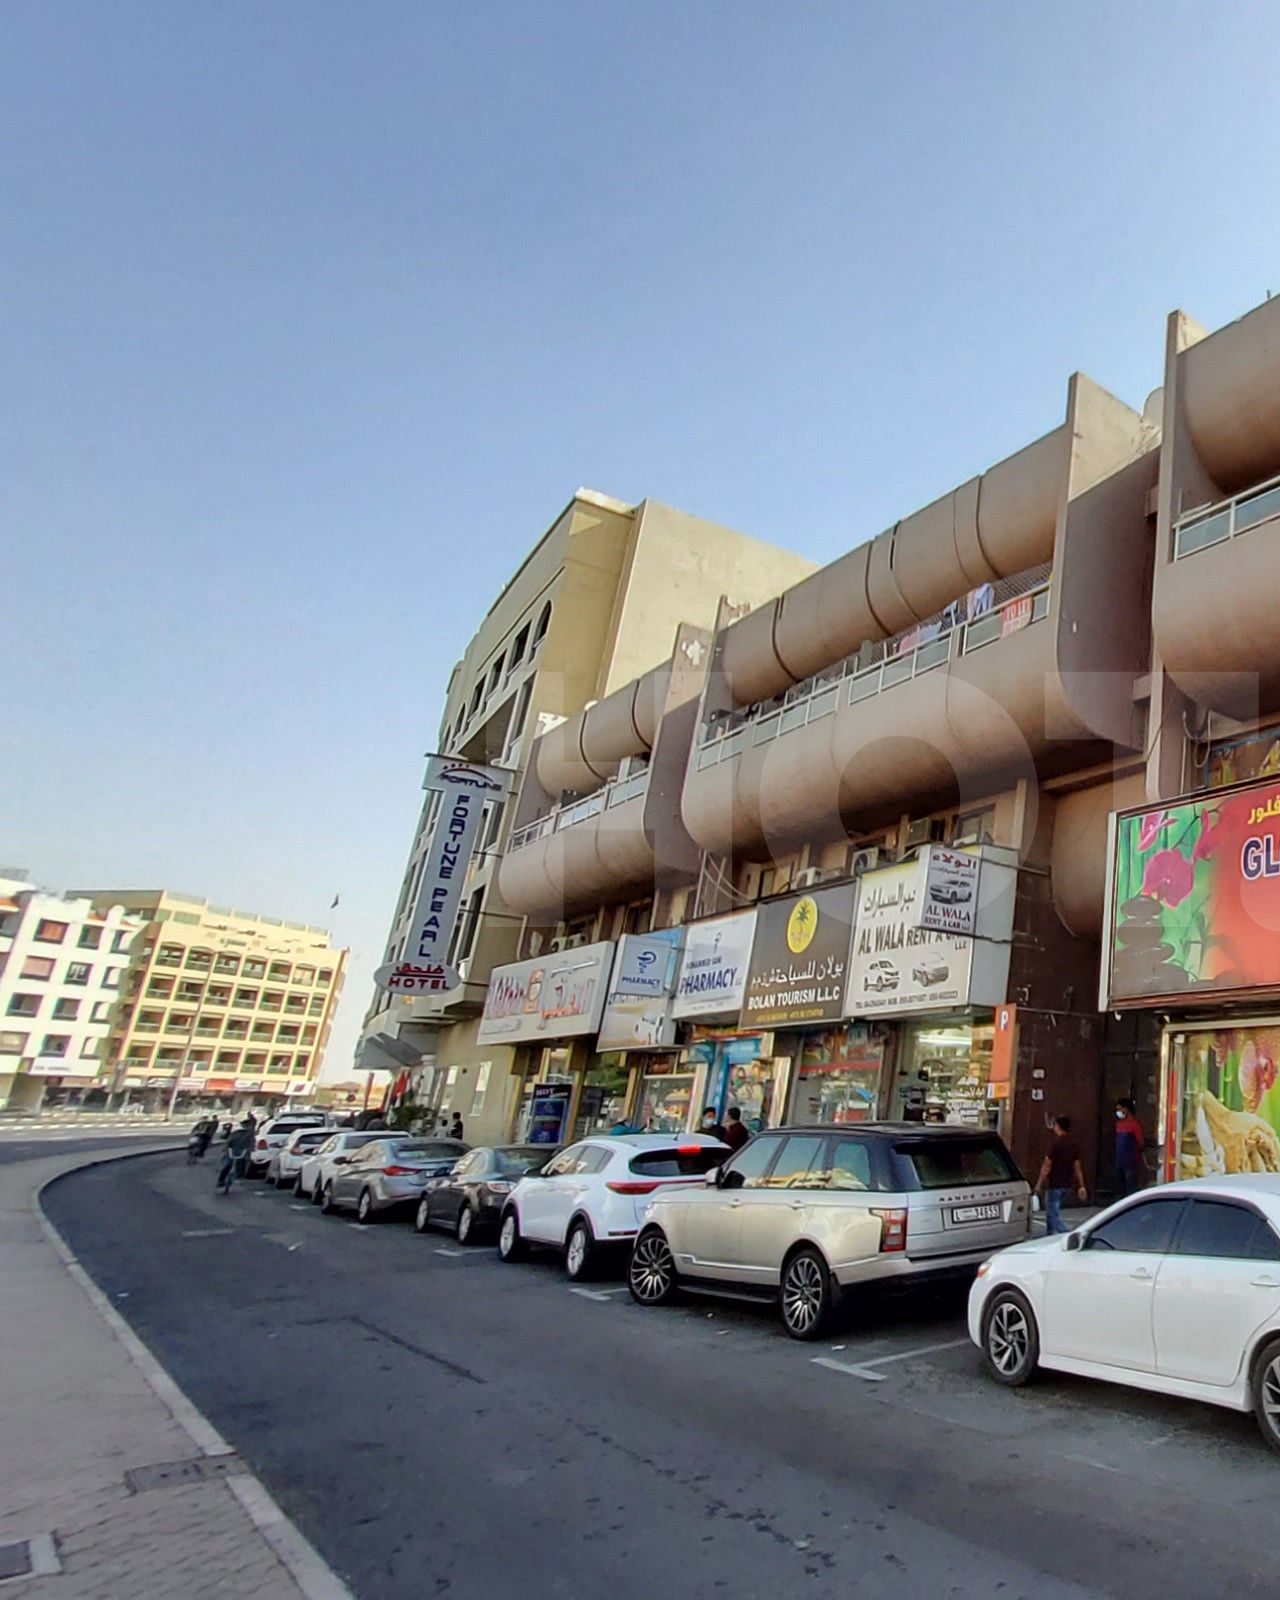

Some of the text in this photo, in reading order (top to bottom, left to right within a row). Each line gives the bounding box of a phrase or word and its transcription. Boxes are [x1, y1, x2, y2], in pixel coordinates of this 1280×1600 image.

[417, 795, 471, 958] FORTUNE PEARL
[924, 916, 941, 926] RENT
[942, 919, 947, 927] A
[948, 920, 960, 928] CAR
[926, 904, 971, 922] AL WALA
[858, 928, 872, 956] AL
[874, 922, 905, 954] WALA
[906, 930, 933, 947] RENT
[816, 954, 844, 981] بولان
[388, 976, 452, 991] HOTEL
[621, 976, 661, 986] PHARMACY
[679, 967, 738, 995] PHARMACY
[747, 992, 776, 1010] BOLAN
[777, 988, 817, 1006] TOURISM
